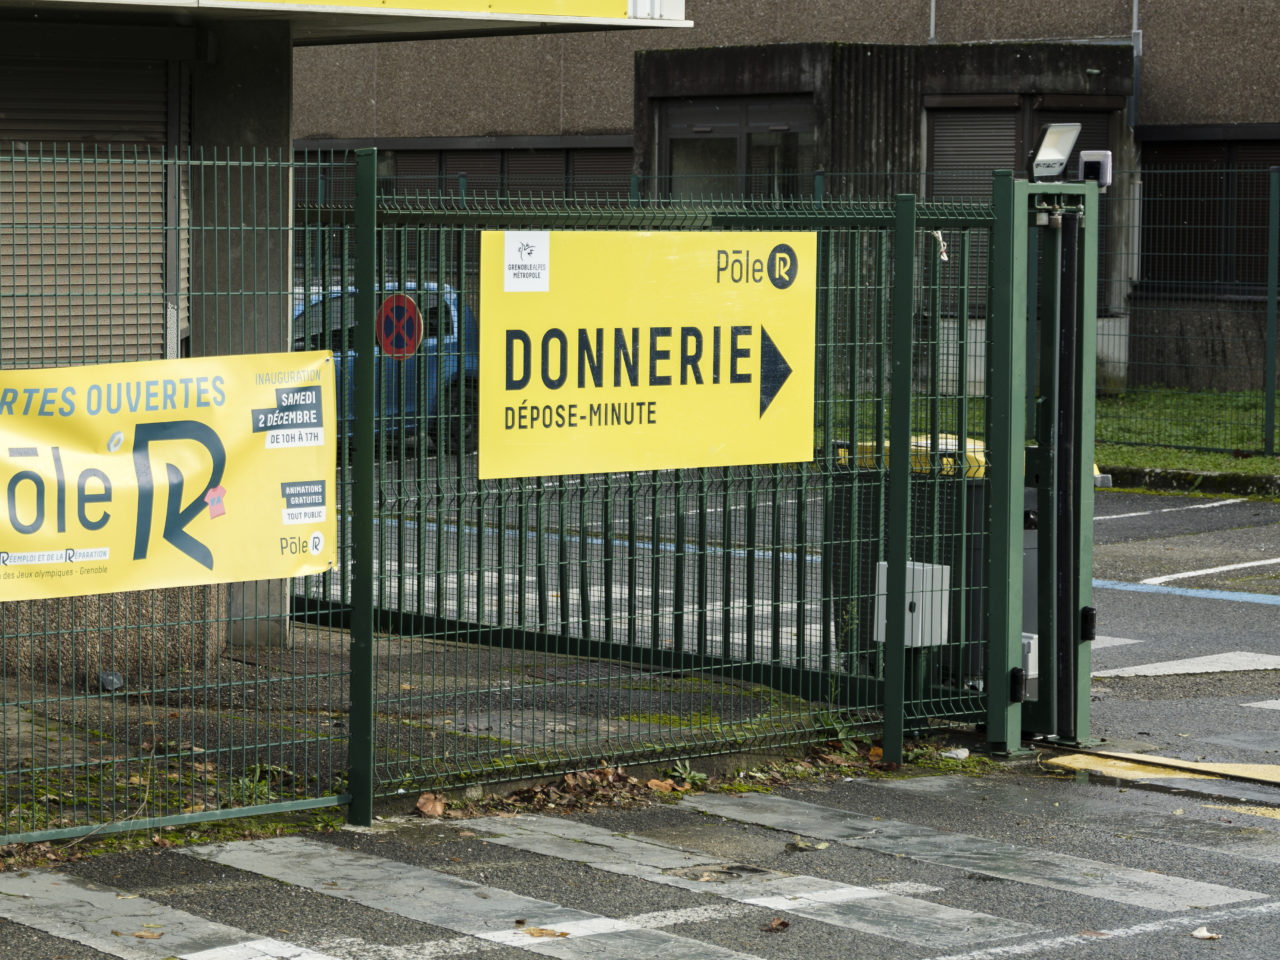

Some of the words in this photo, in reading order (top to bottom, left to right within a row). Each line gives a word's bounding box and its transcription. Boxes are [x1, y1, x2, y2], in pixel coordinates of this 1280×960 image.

[513, 271, 541, 279] MÉTROPOLE
[505, 325, 753, 391] DONNERIE
[255, 370, 321, 385] INAUGURATION
[86, 375, 226, 416] OUVERTES
[282, 392, 316, 407] SAMEDI
[258, 415, 265, 427] 2
[267, 410, 317, 427] DÉCEMBRE
[504, 399, 657, 430] DÉPOSE-MINUTE
[270, 434, 280, 444] DE
[282, 433, 296, 443] 10H
[298, 431, 304, 442] À
[306, 432, 319, 442] 17H
[133, 420, 226, 571] R
[286, 485, 322, 494] ANIMATIONS
[291, 495, 322, 504] GRATUITES
[287, 512, 302, 520] TOUT
[304, 511, 322, 519] PUBLIC
[3, 572, 15, 580] des
[16, 571, 32, 579] Jeux
[34, 568, 73, 579] olympiques
[80, 566, 108, 575] Grenoble
